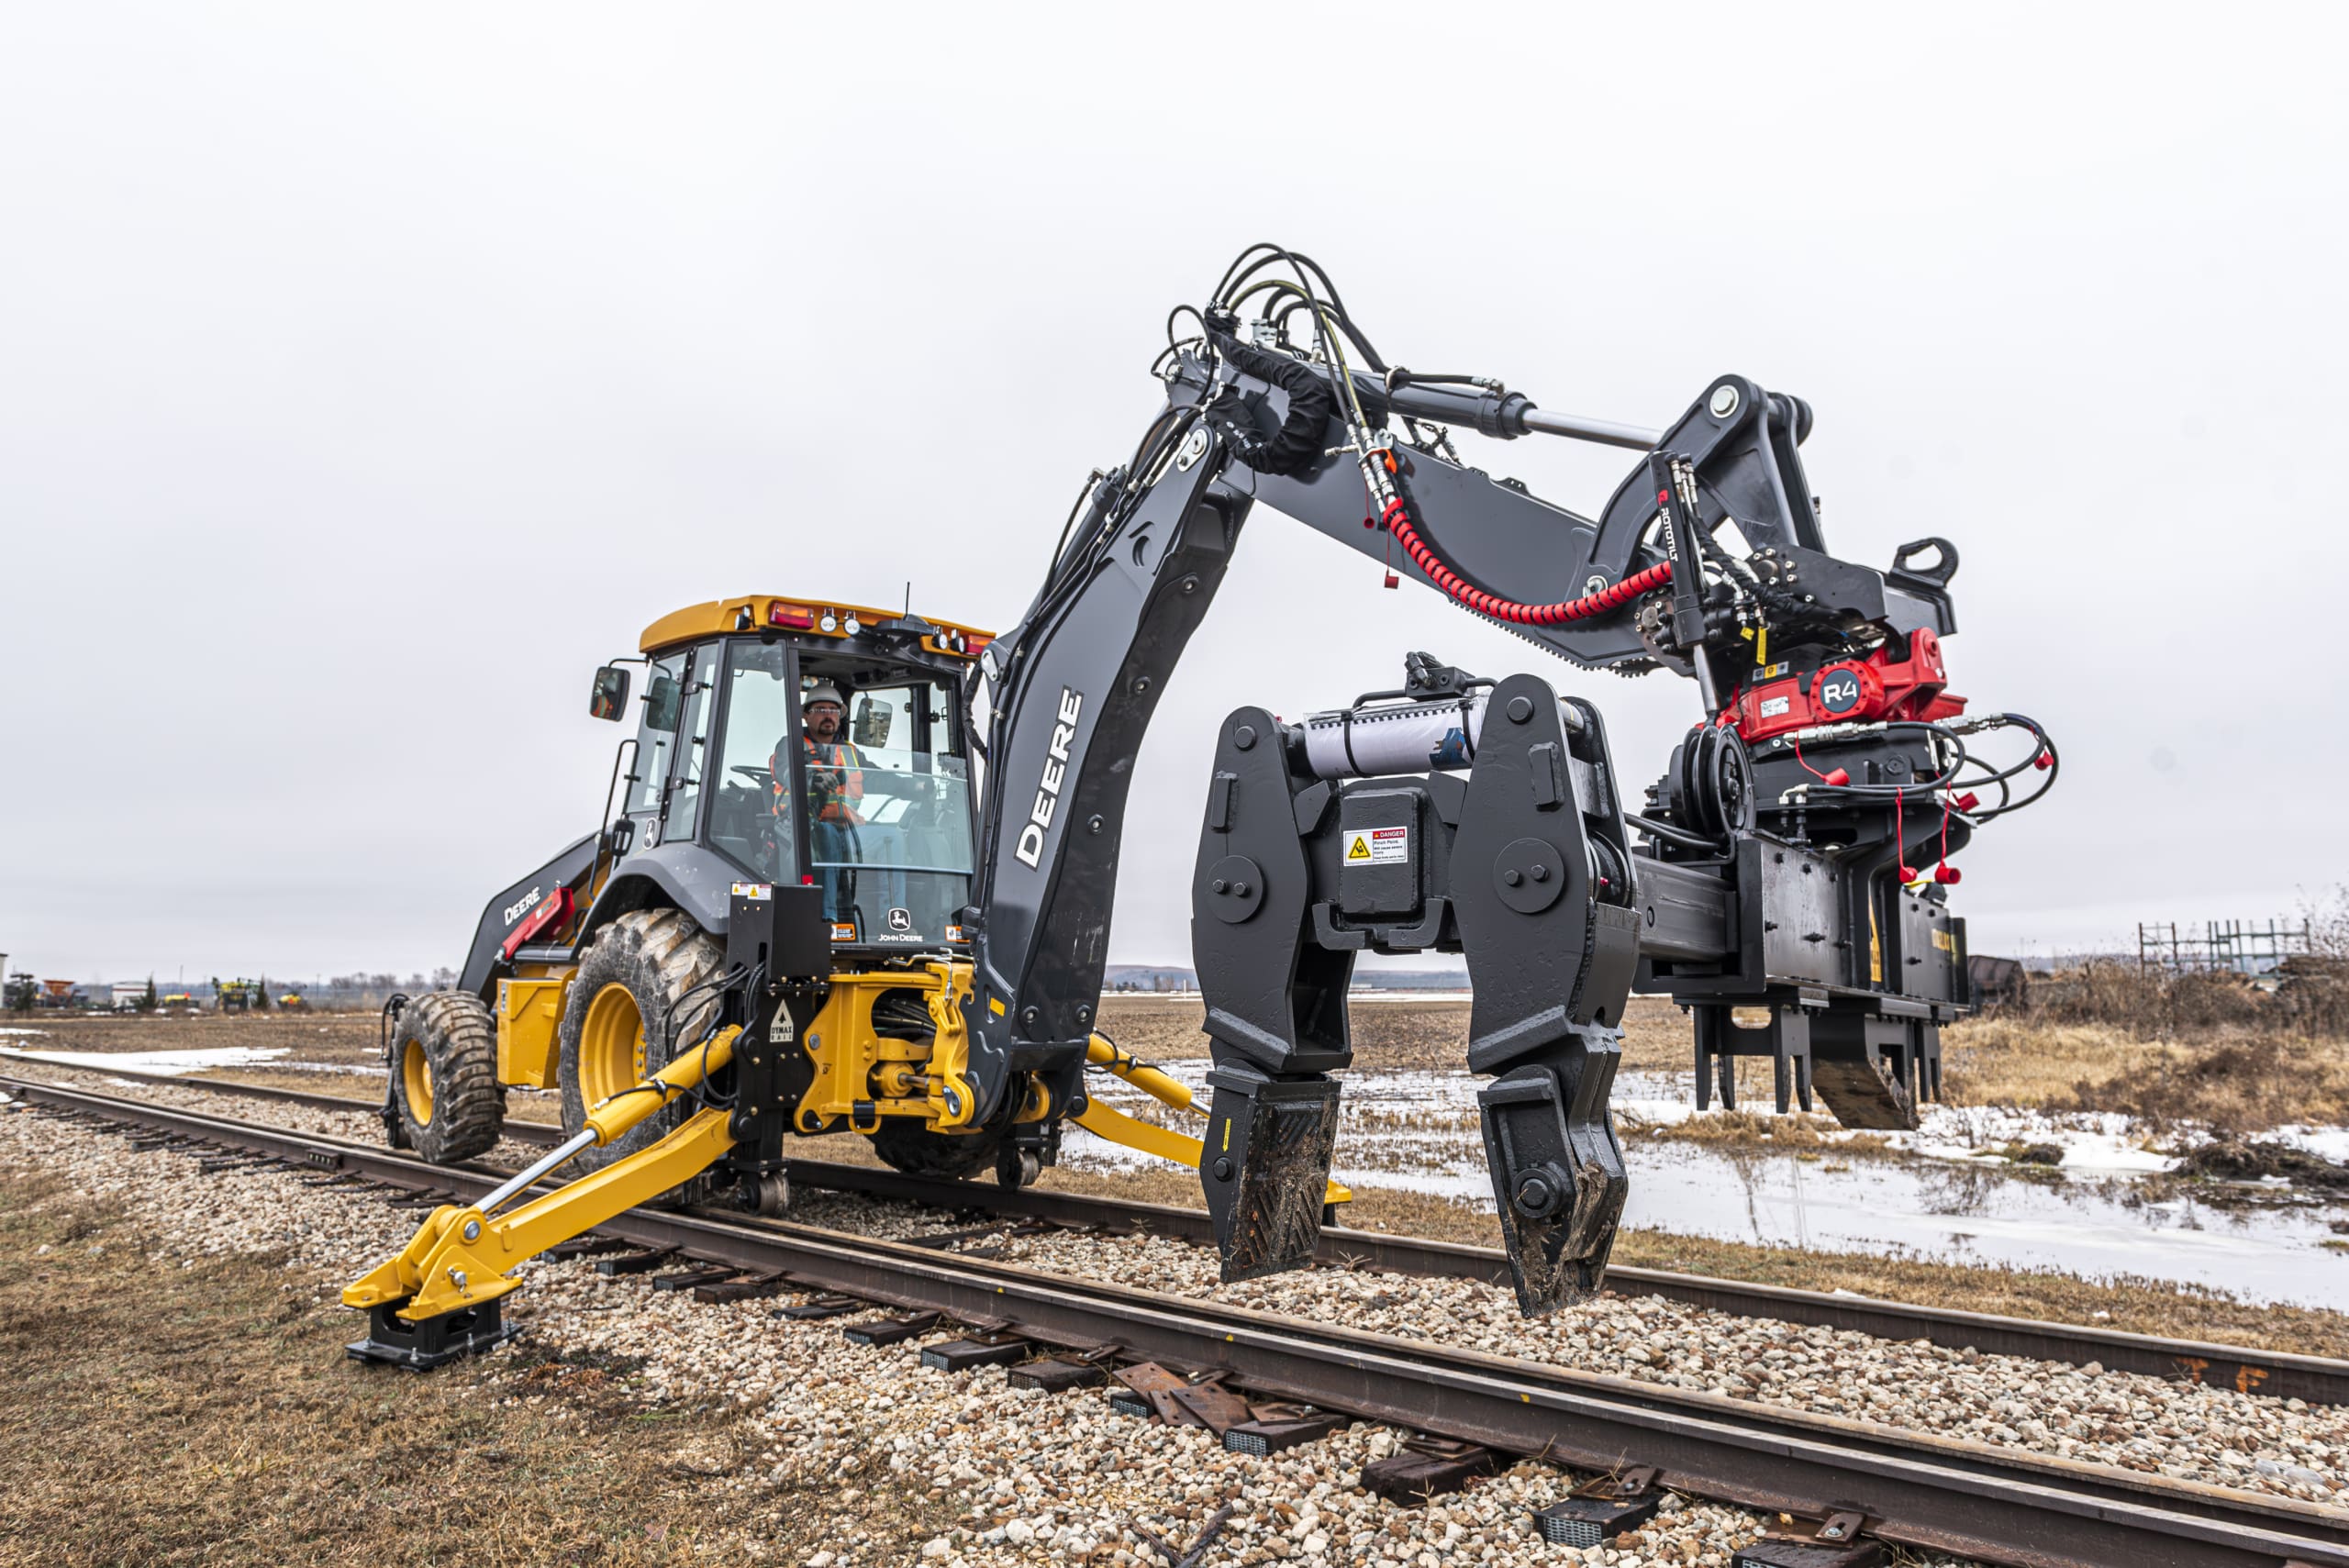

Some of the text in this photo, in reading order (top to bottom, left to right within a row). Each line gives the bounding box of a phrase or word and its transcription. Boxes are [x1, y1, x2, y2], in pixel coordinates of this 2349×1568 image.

[1661, 507, 1678, 562] ROTOTILT
[1823, 680, 1858, 705] R4
[1015, 687, 1083, 870] DEERE
[1380, 830, 1404, 839] DANGER
[504, 886, 540, 927] DEERE
[878, 933, 924, 942] JOHN DEERE
